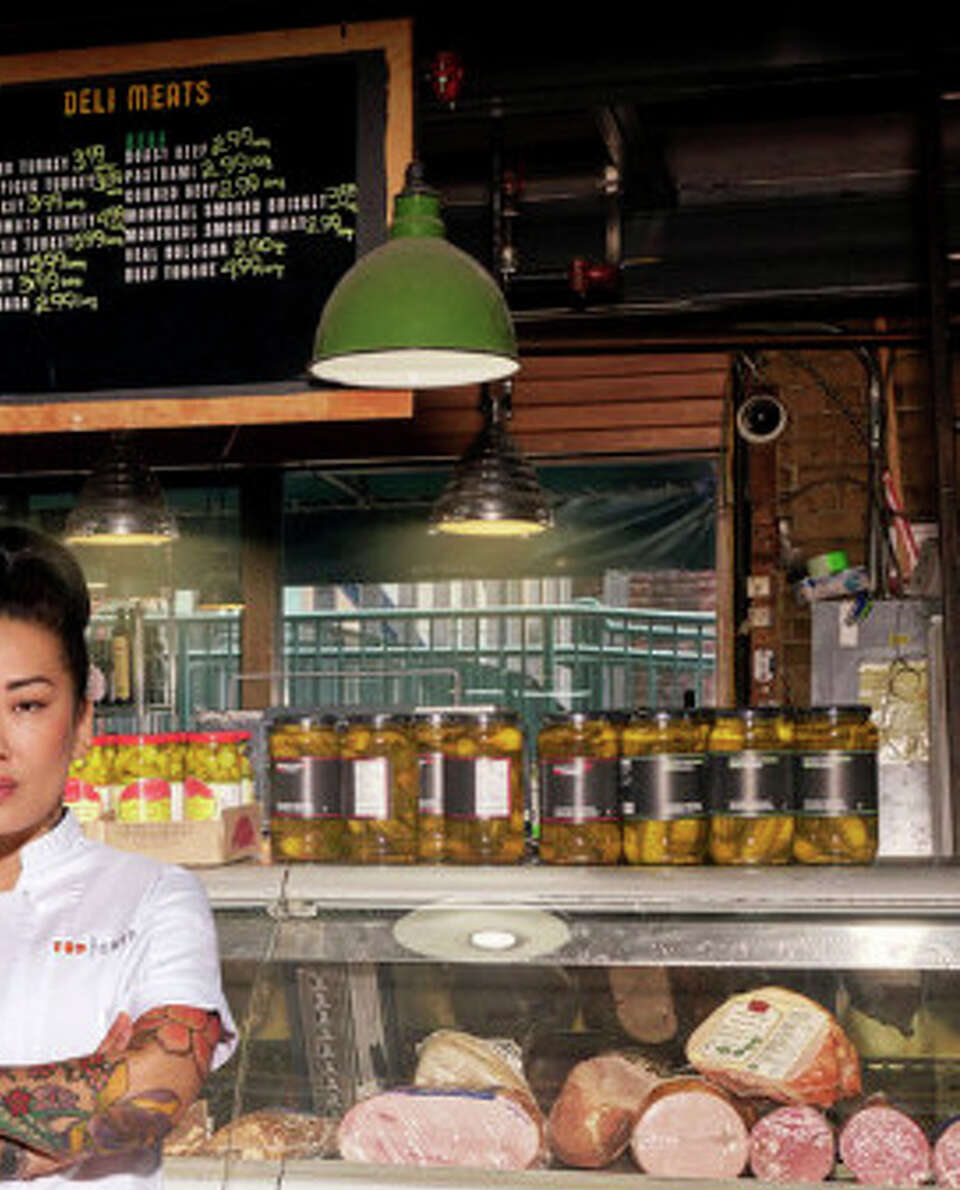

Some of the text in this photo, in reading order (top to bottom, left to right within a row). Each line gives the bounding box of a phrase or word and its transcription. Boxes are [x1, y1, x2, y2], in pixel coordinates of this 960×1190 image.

[64, 80, 211, 115] DELI MEATS
[125, 165, 197, 184] PASTRAMI
[125, 186, 181, 204] CORNED
[185, 182, 218, 199] BEEF
[204, 200, 262, 218] SMOKED
[47, 213, 96, 231] TURKEY
[204, 219, 262, 238] SMOKED
[53, 940, 88, 956] TOP
